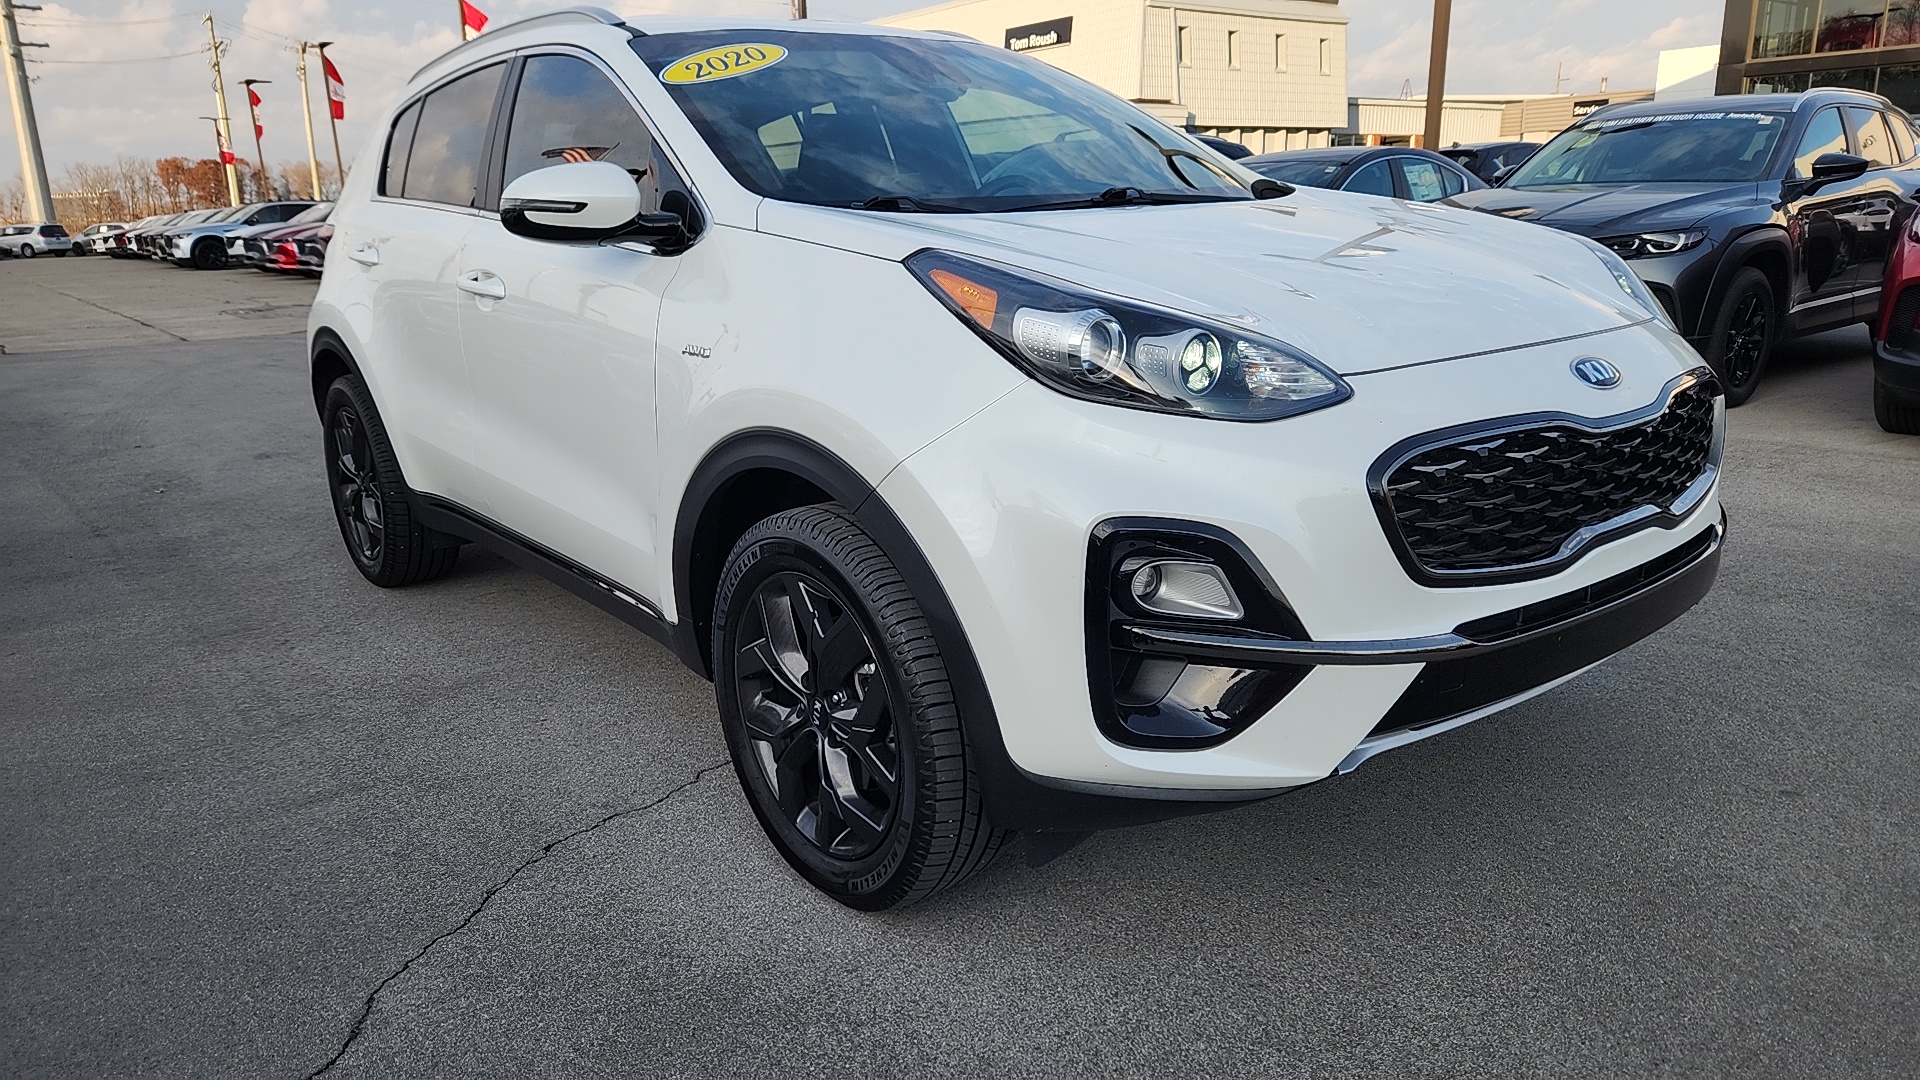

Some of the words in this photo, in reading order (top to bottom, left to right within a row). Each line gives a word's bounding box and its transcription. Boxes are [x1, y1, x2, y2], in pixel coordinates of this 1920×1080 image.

[1009, 37, 1029, 51] Tom
[1029, 30, 1058, 48] Roush
[684, 46, 767, 79] 2020
[1617, 115, 1654, 126] LEATHER
[1653, 112, 1694, 122] INTERIOR
[1692, 112, 1727, 121] INSIDE
[681, 344, 712, 359] AWD
[1576, 359, 1618, 383] KIA
[722, 545, 760, 607] MICHELIN
[813, 700, 822, 726] KIA
[851, 846, 900, 892] MICHELIN
